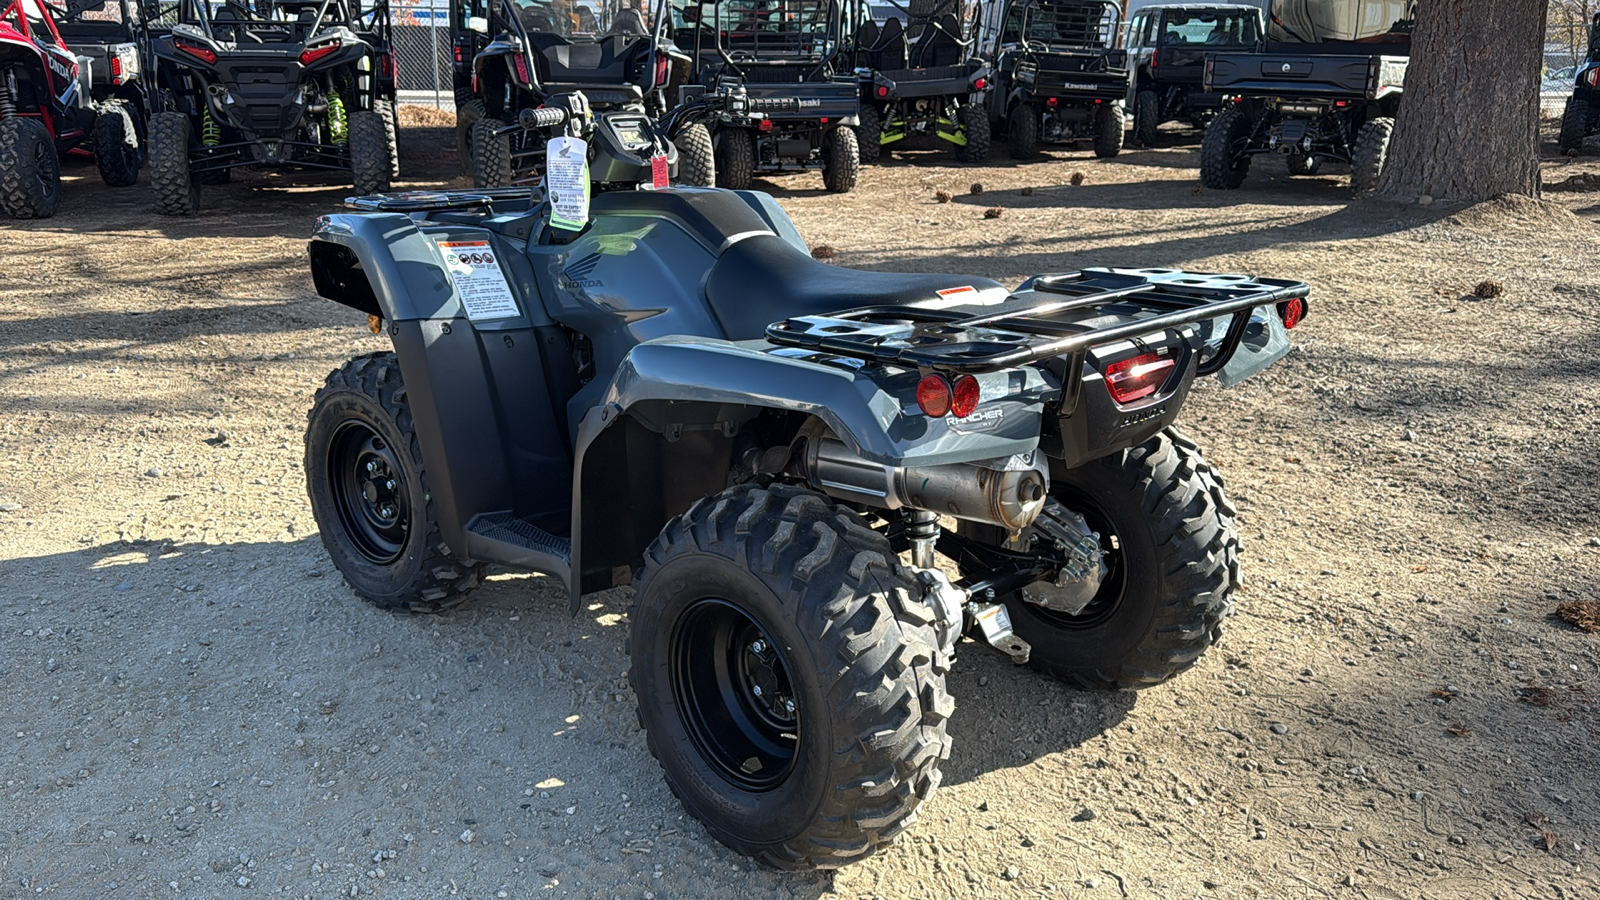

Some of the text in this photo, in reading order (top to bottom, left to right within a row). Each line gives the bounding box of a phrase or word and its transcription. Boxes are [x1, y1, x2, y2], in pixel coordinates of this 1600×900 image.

[1064, 82, 1098, 91] Kawasaki
[564, 280, 604, 289] HONDA
[945, 409, 1004, 426] RANCHER
[1120, 405, 1166, 428] HONDA
